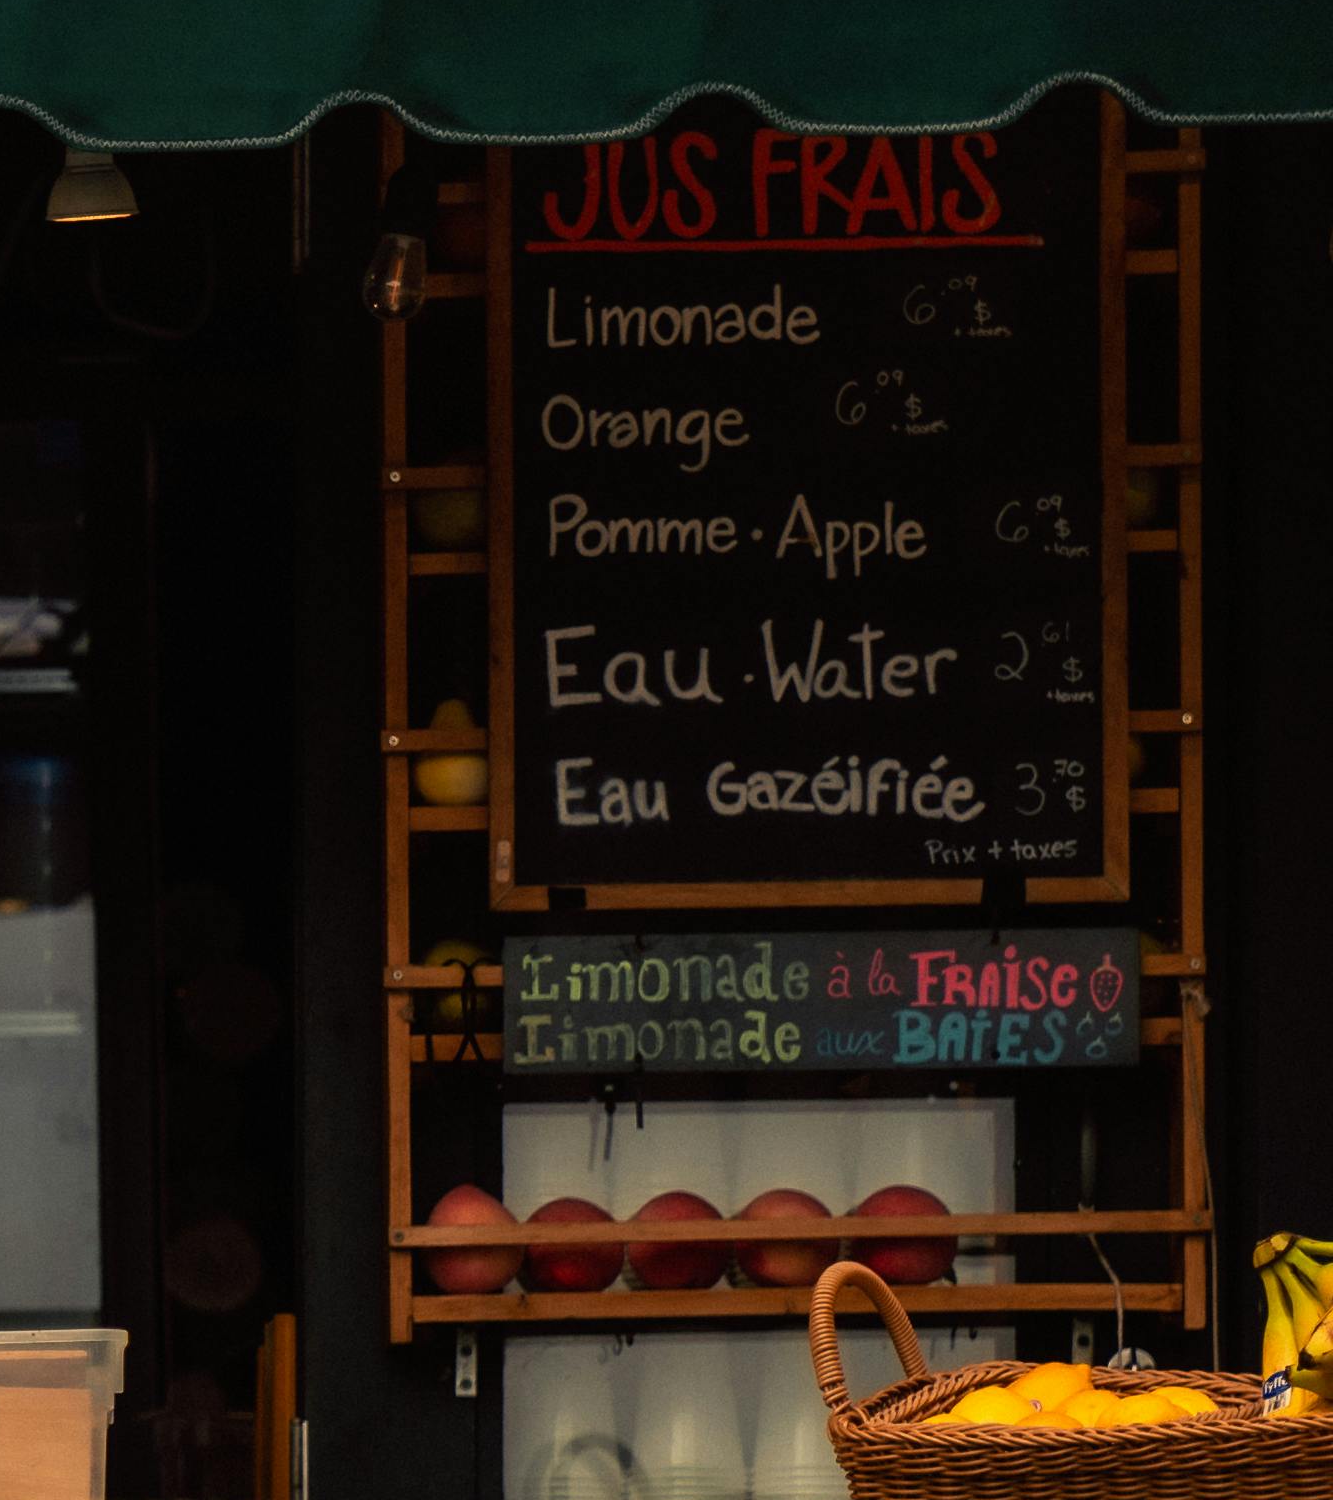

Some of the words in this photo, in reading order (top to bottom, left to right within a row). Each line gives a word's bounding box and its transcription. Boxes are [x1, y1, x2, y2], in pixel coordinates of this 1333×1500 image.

[542, 131, 717, 240] JUS
[752, 127, 1003, 238] FRAIS
[545, 282, 822, 350] Limonade
[540, 392, 751, 473] Orange
[547, 493, 738, 558] Pomme
[774, 494, 928, 580] Apple
[544, 624, 724, 708] Eau
[761, 618, 958, 705] Water
[554, 756, 671, 828] Eau
[706, 753, 987, 825] Gazéifiée
[924, 839, 977, 866] Prix
[1010, 839, 1078, 861] taxes
[521, 941, 811, 1005] Limonade
[826, 950, 854, 1000] à
[867, 945, 903, 997] la
[513, 1009, 802, 1067] Limonade
[815, 1025, 886, 1058] aux
